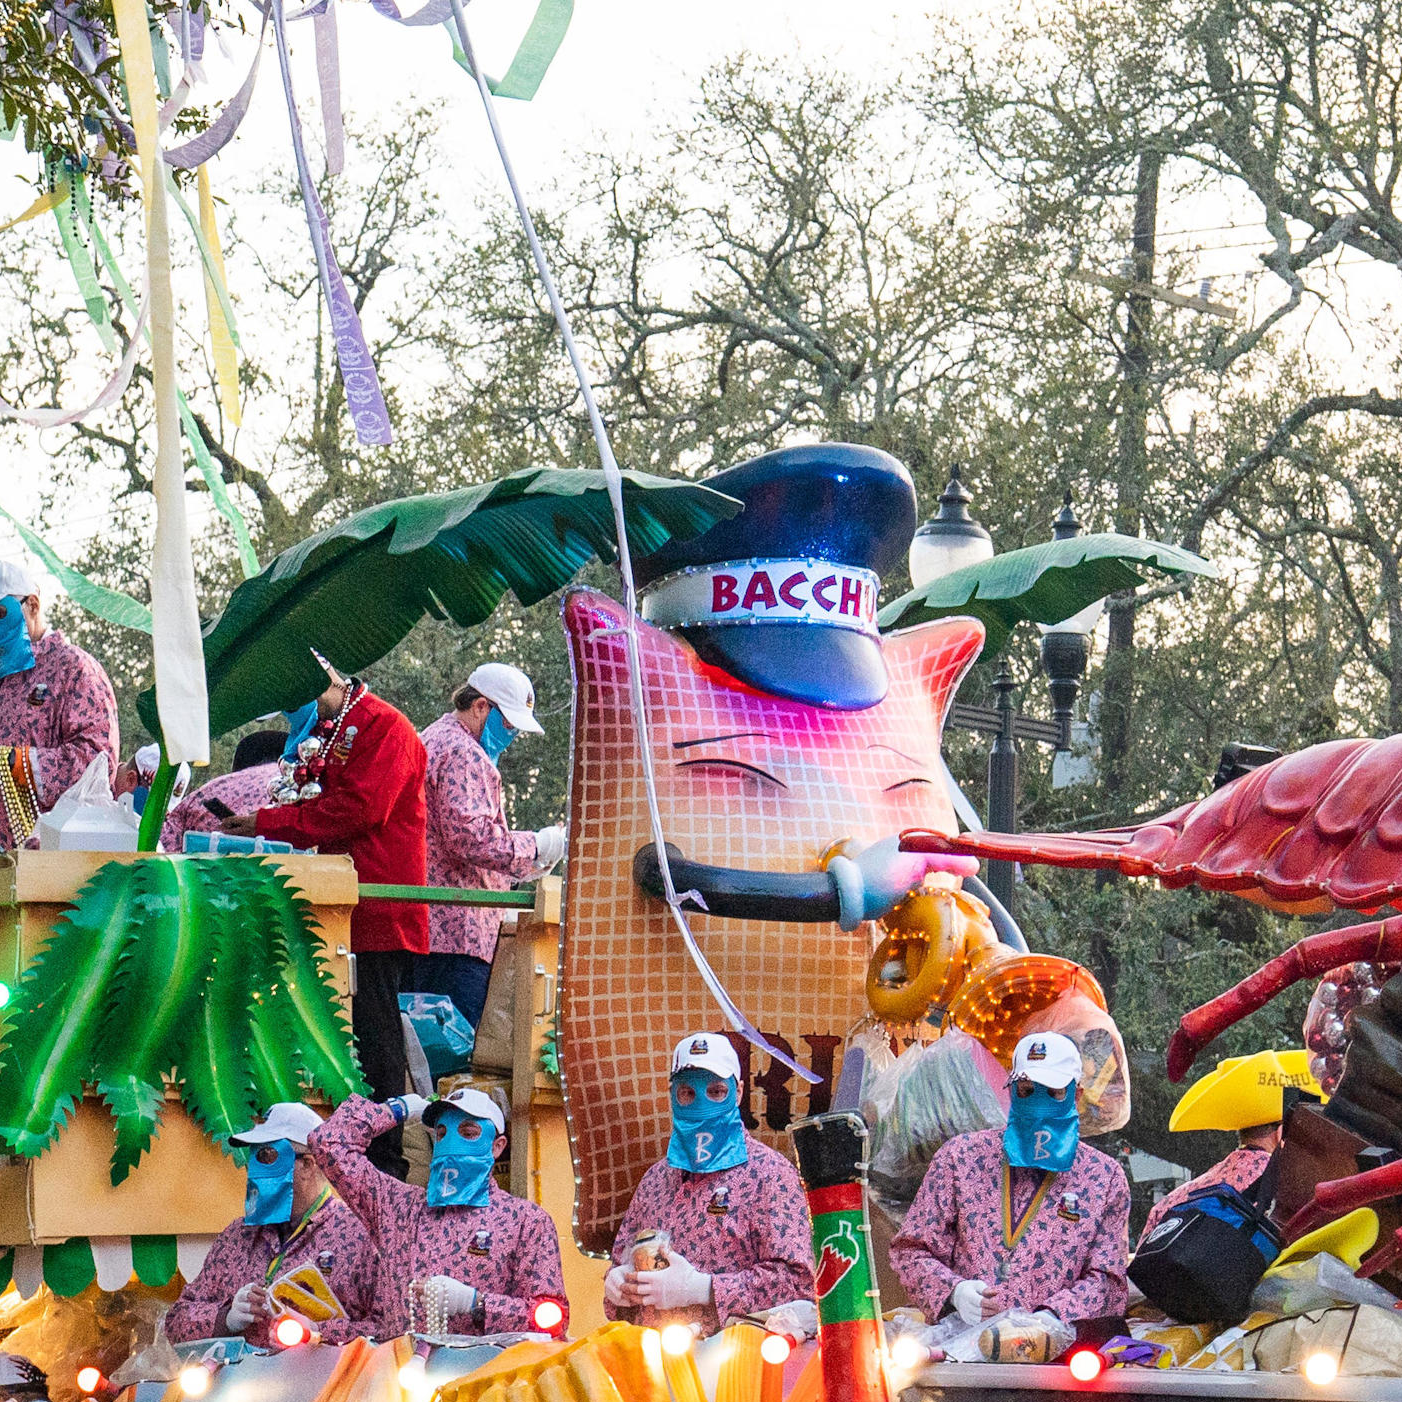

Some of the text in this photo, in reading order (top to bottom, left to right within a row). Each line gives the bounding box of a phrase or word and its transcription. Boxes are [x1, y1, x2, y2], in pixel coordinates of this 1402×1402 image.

[1257, 1071, 1315, 1088] BACCHU
[695, 1131, 714, 1163] B
[1034, 1130, 1052, 1161] B
[441, 1167, 459, 1197] B
